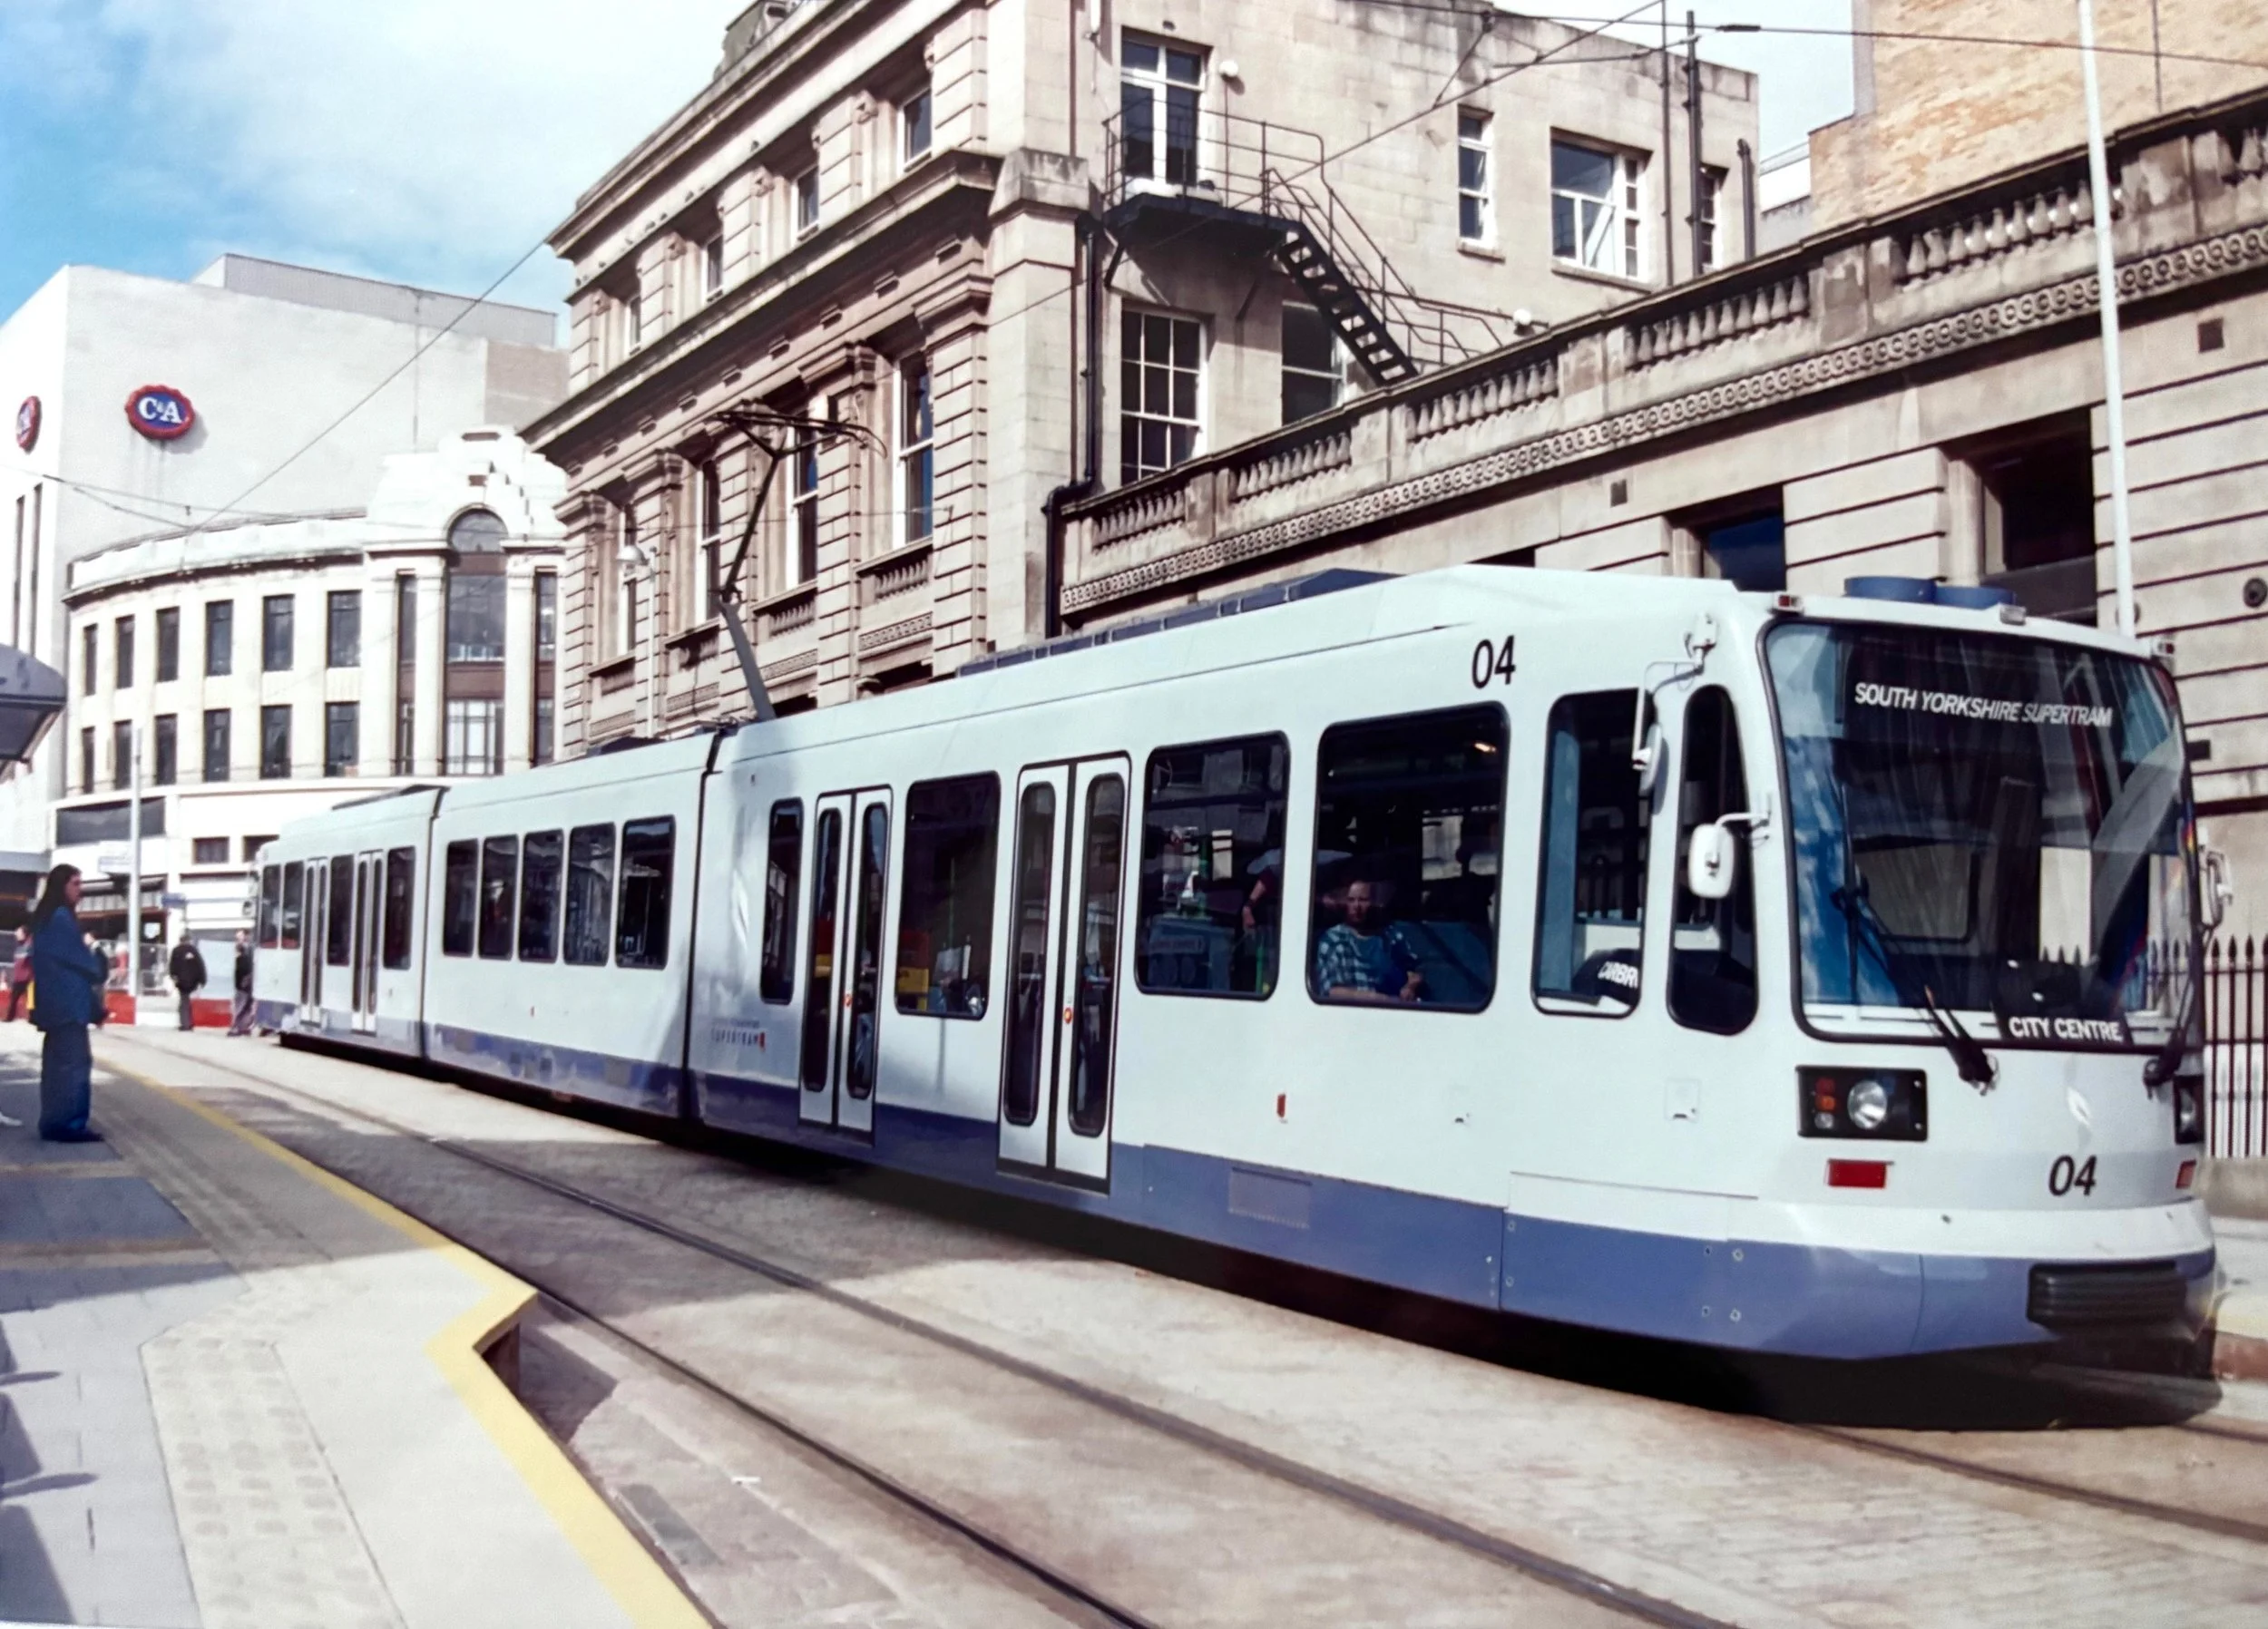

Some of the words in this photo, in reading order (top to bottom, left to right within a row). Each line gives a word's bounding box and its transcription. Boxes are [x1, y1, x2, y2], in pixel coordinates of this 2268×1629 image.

[138, 396, 182, 424] C&A
[1471, 634, 1516, 689] 04
[1854, 682, 1918, 710] SOUTH
[1921, 690, 2023, 722] YORKSHIRE
[2022, 703, 2113, 727] SUPERTRAM
[2008, 1016, 2050, 1039] CITY
[2053, 1017, 2124, 1042] CENTRE
[2048, 1155, 2097, 1196] 04
